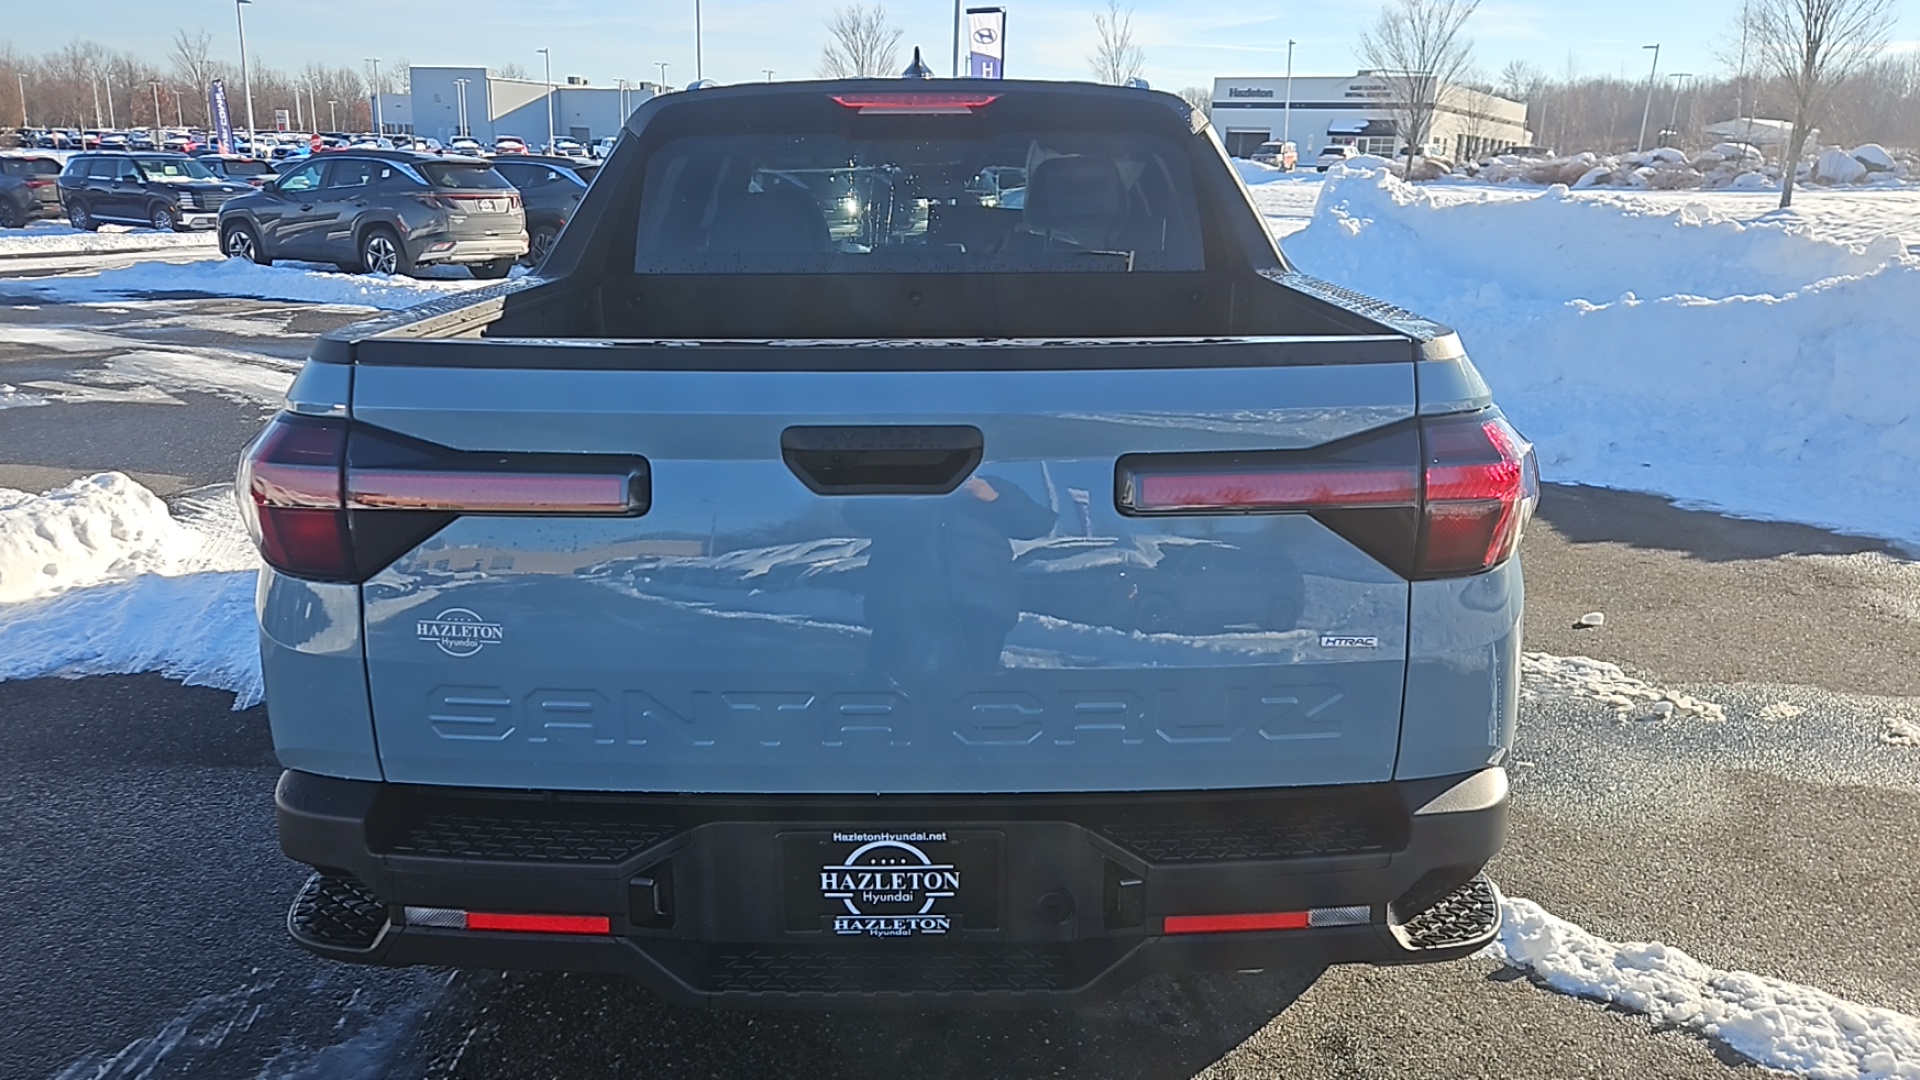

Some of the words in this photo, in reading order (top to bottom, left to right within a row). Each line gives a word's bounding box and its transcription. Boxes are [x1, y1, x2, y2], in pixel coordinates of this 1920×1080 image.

[1229, 87, 1273, 97] Hazleton
[416, 623, 503, 639] HAZLETON
[441, 637, 478, 648] Hyundai
[1325, 638, 1375, 646] HTRAC
[426, 684, 911, 747] SANTA
[953, 684, 1345, 746] CRUZ
[833, 832, 947, 842] HazletonHyundai.net
[820, 871, 961, 890] HAZLETON
[862, 890, 914, 904] Hyundai
[833, 918, 951, 931] HAZLETON
[869, 928, 912, 938] Hyundai
